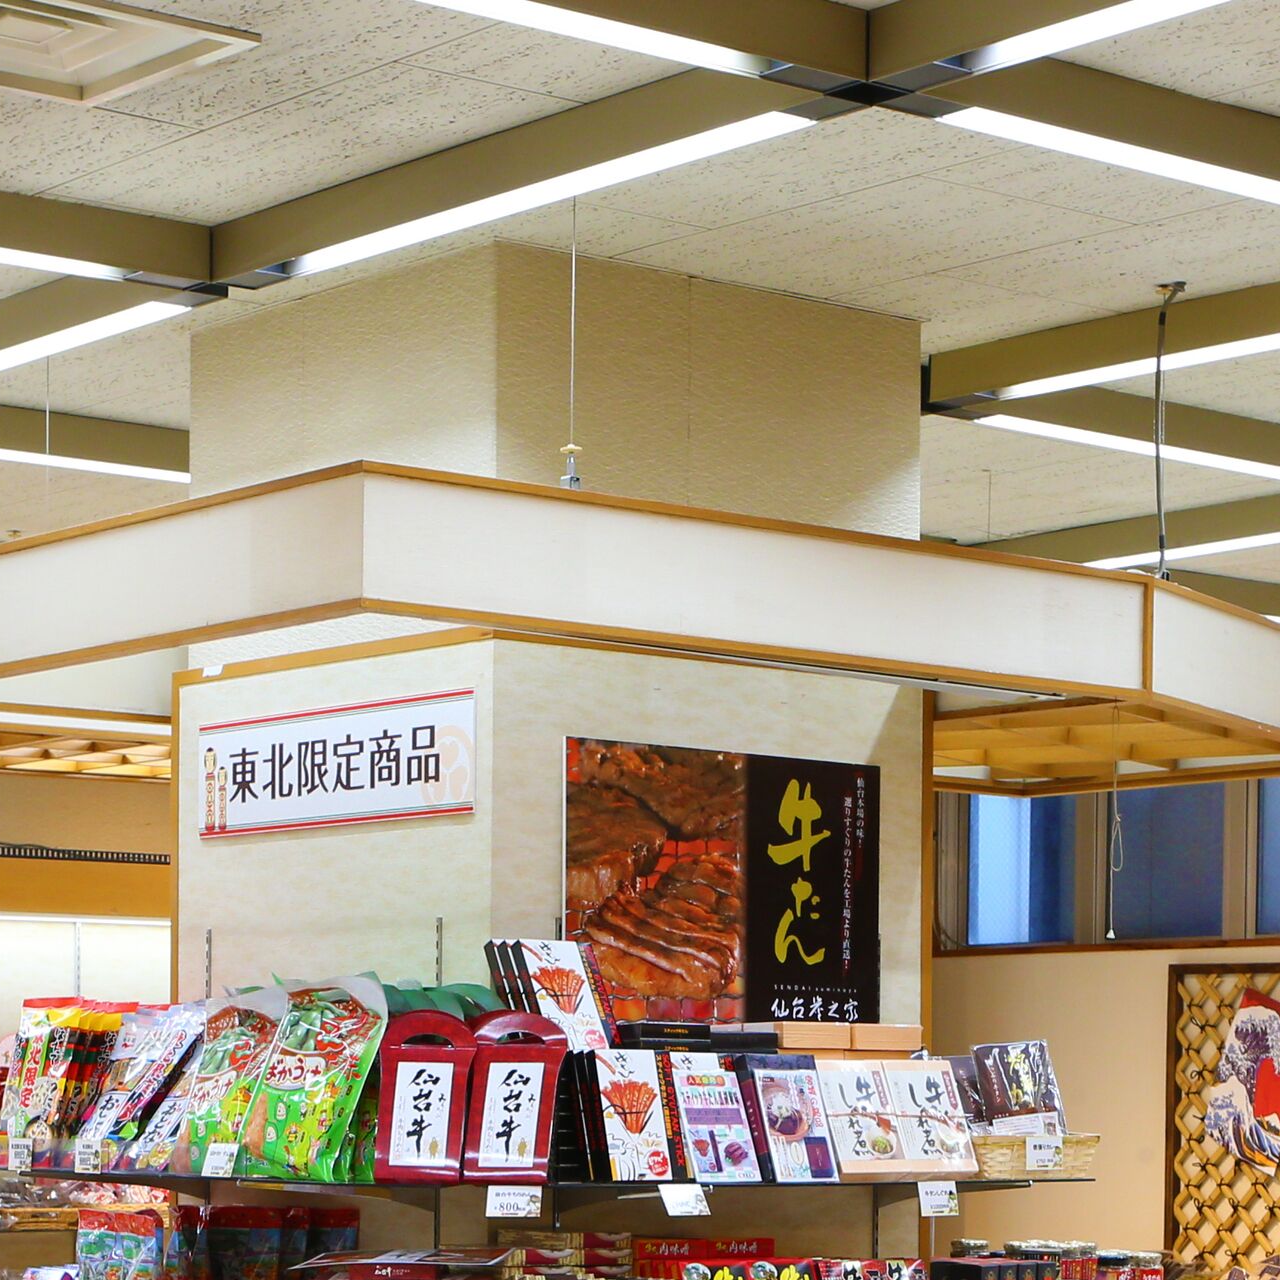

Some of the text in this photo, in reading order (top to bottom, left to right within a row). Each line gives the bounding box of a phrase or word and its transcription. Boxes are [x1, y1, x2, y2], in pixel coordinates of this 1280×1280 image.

[229, 724, 441, 803] 東北限定商品
[767, 778, 831, 965] 牛たん
[774, 983, 811, 991] SENDAI
[406, 1069, 440, 1160] 仙台牛
[496, 1069, 531, 1163] 仙台牛
